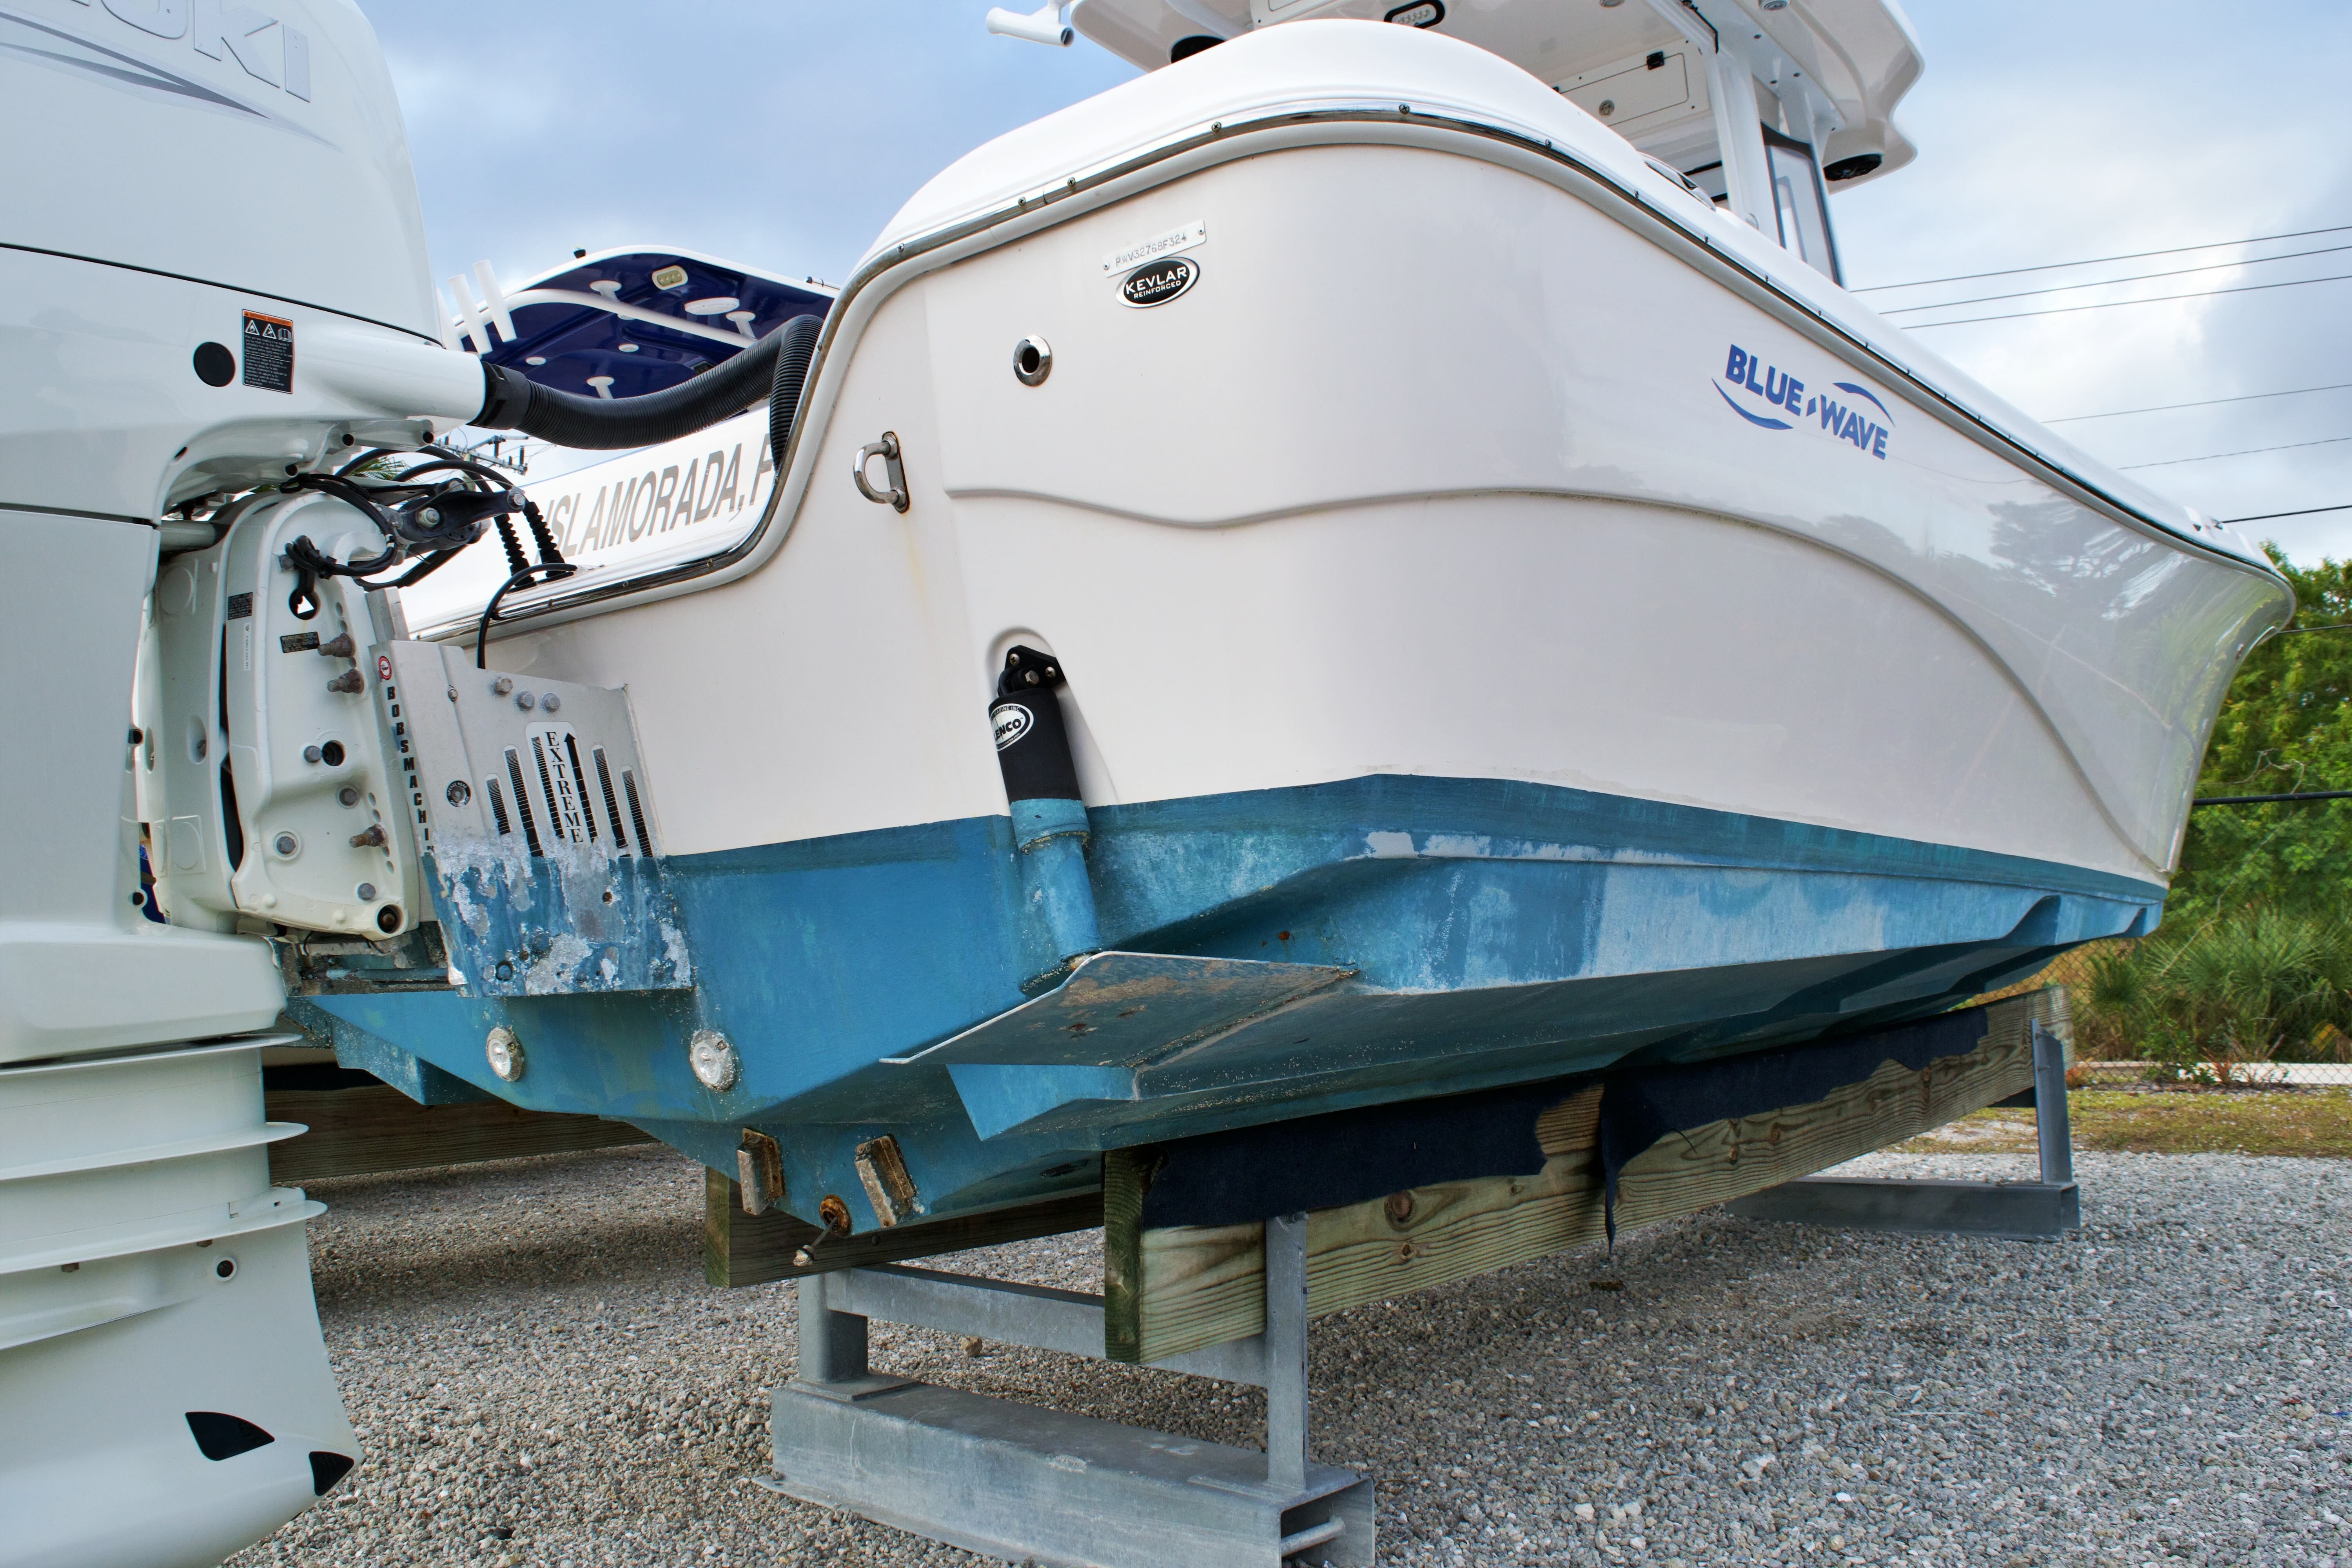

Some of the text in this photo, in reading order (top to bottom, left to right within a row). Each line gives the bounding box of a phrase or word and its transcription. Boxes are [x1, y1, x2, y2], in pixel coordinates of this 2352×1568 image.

[1126, 266, 1187, 295] KEVLAR
[1134, 280, 1181, 299] REINFORCED
[1726, 344, 1888, 460] BLUE WAVE
[994, 706, 1009, 715] MARINE
[448, 782, 457, 796] GREASE
[545, 732, 583, 843] EXTREME
